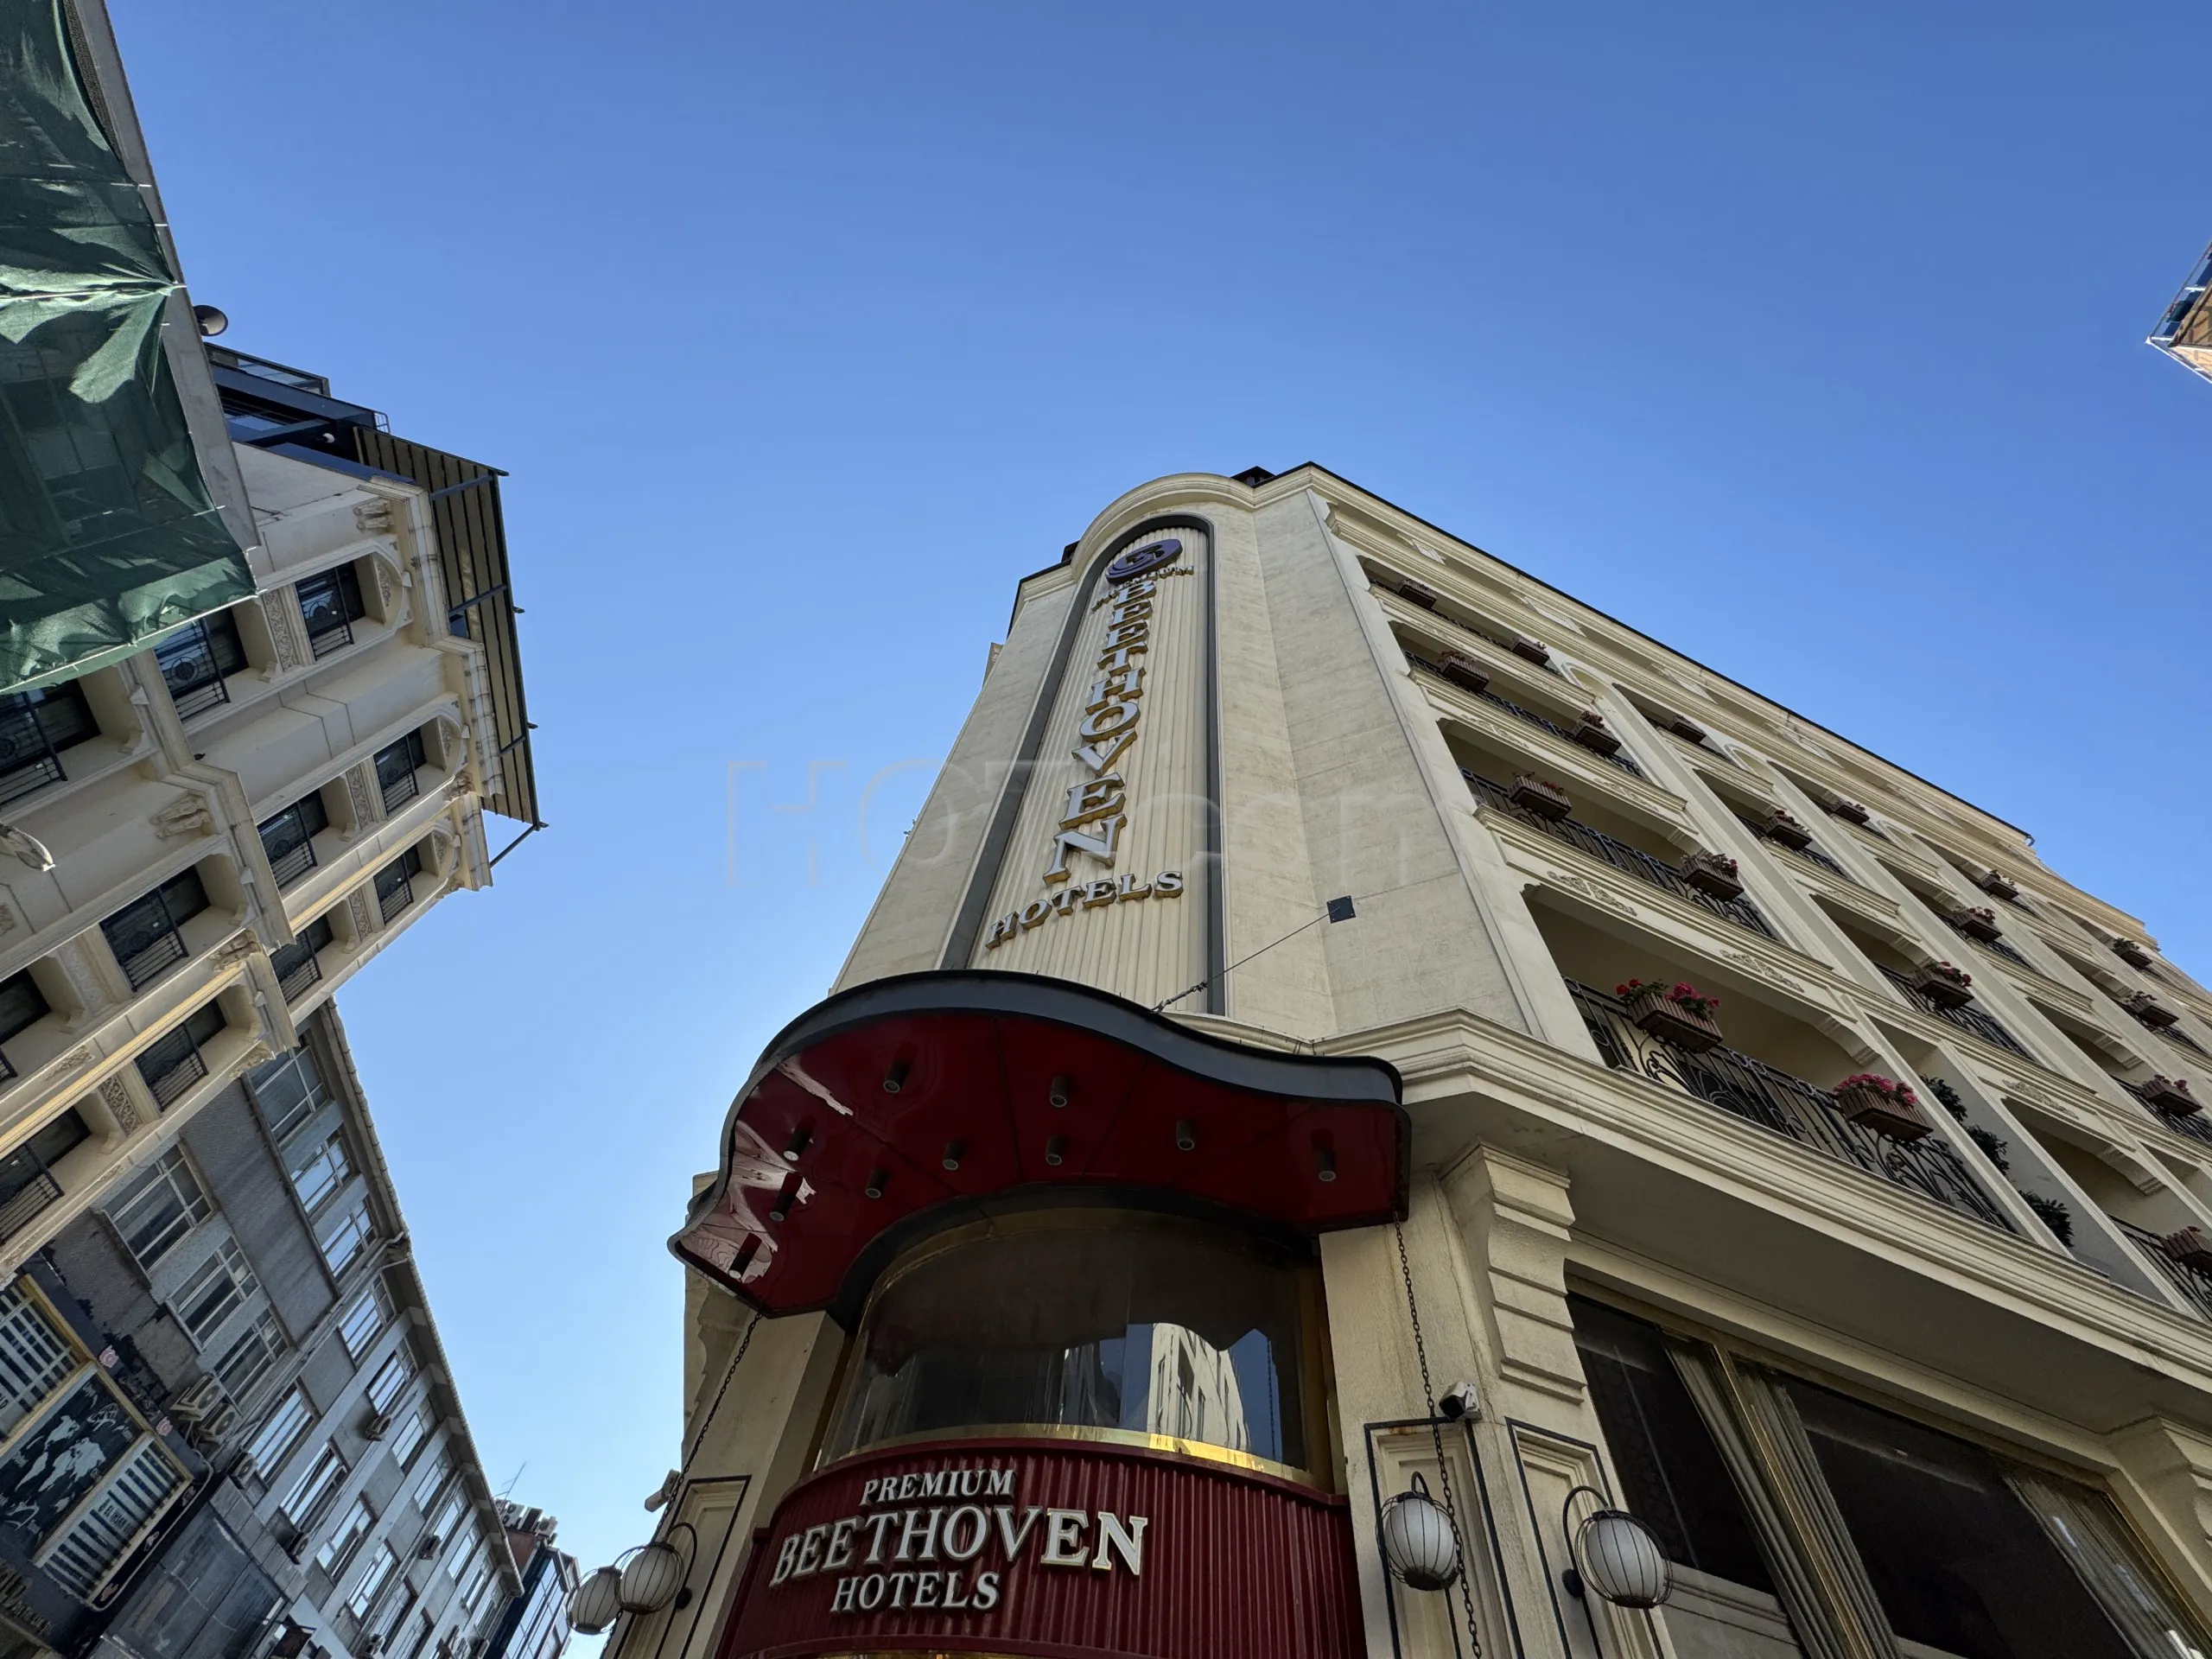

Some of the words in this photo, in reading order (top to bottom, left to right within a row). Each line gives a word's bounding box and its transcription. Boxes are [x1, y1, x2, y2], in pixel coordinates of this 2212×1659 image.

[1043, 580, 1157, 885] BEETHOVEN
[985, 870, 1183, 950] HOTELS
[859, 1469, 1016, 1506] PREMIUM
[769, 1504, 1149, 1588] BEETHOVEN
[829, 1571, 1001, 1613] HOTELS
